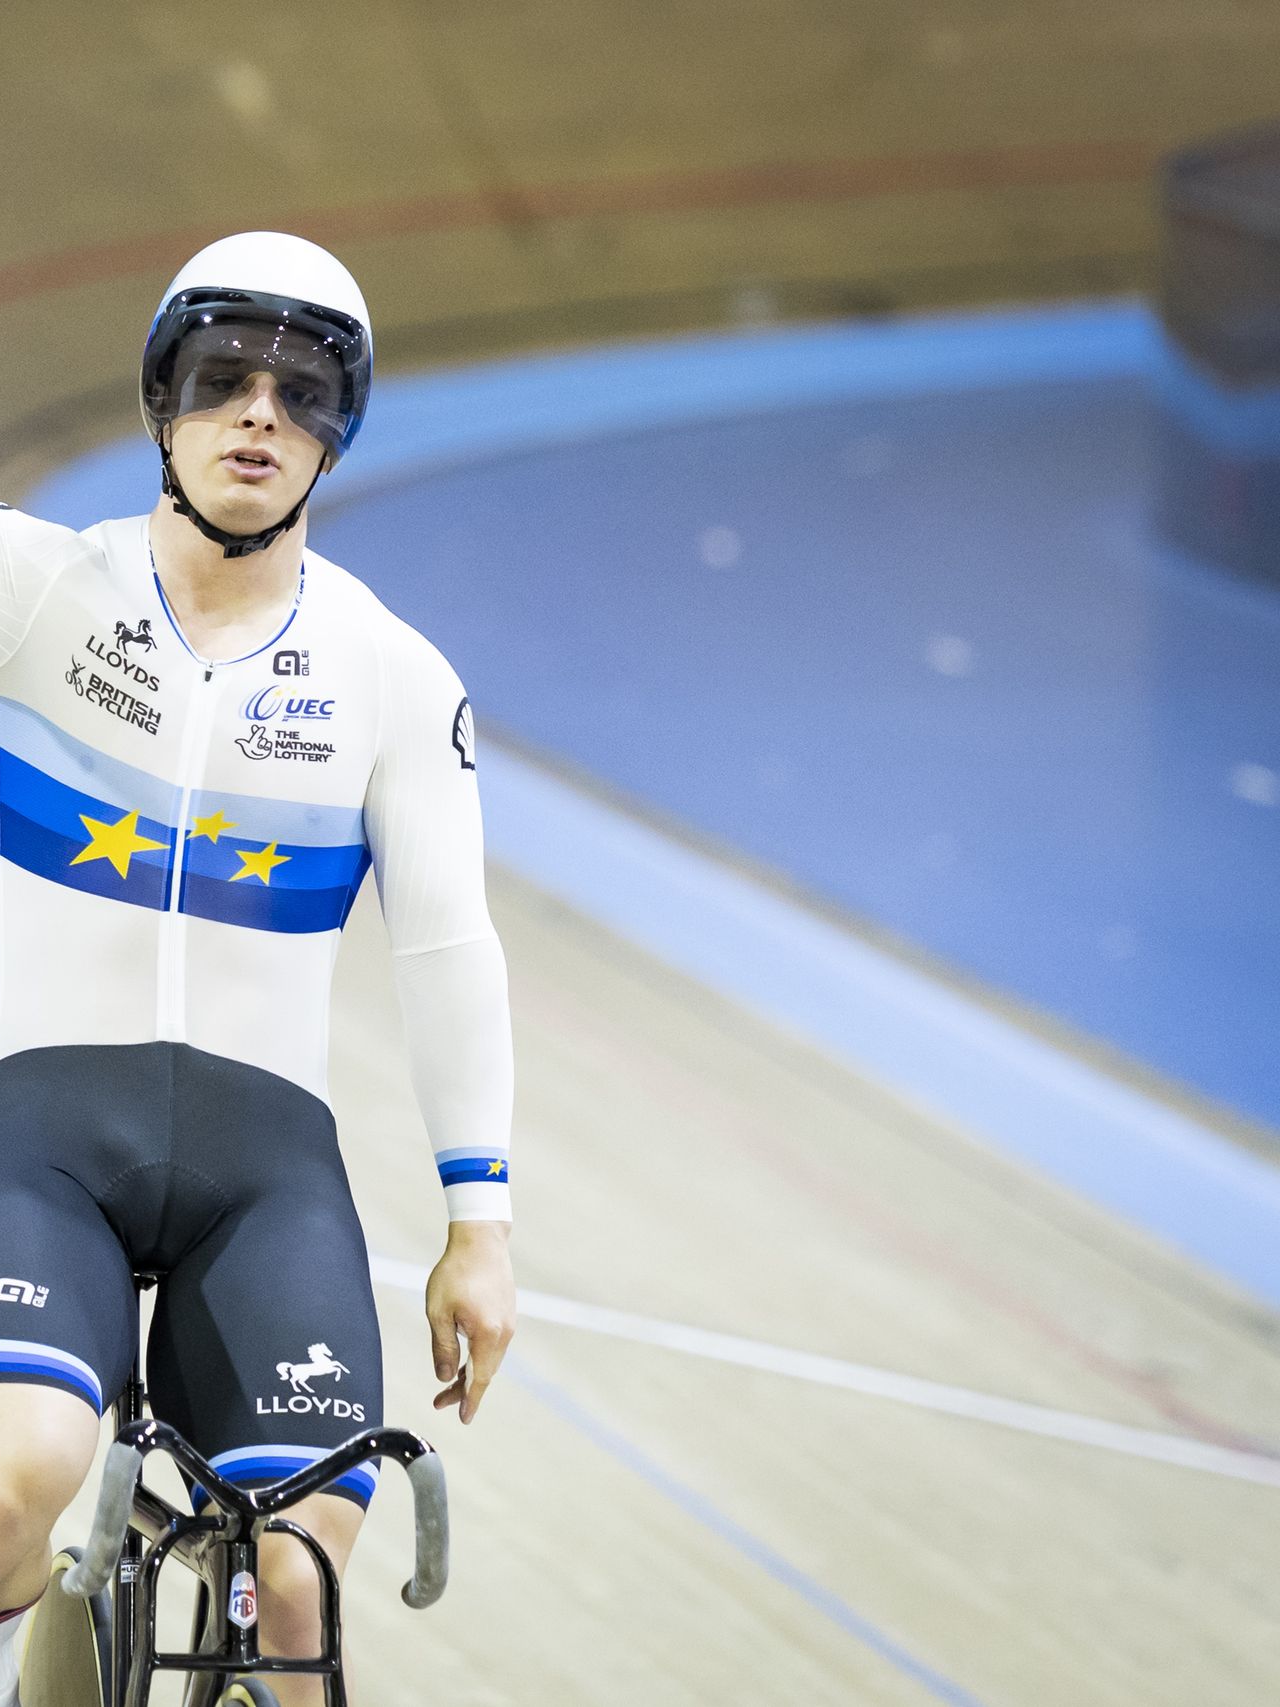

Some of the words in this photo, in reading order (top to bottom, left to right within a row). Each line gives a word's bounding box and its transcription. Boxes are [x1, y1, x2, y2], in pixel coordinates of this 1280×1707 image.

[85, 635, 160, 692] LLOYDS
[88, 673, 162, 724] BRITISH
[285, 698, 336, 716] UEC
[85, 687, 159, 736] CYCLING
[275, 730, 300, 740] THE
[275, 740, 336, 753] NATIONAL
[275, 750, 331, 763] LOTTERY
[256, 1396, 366, 1422] LLOYDS
